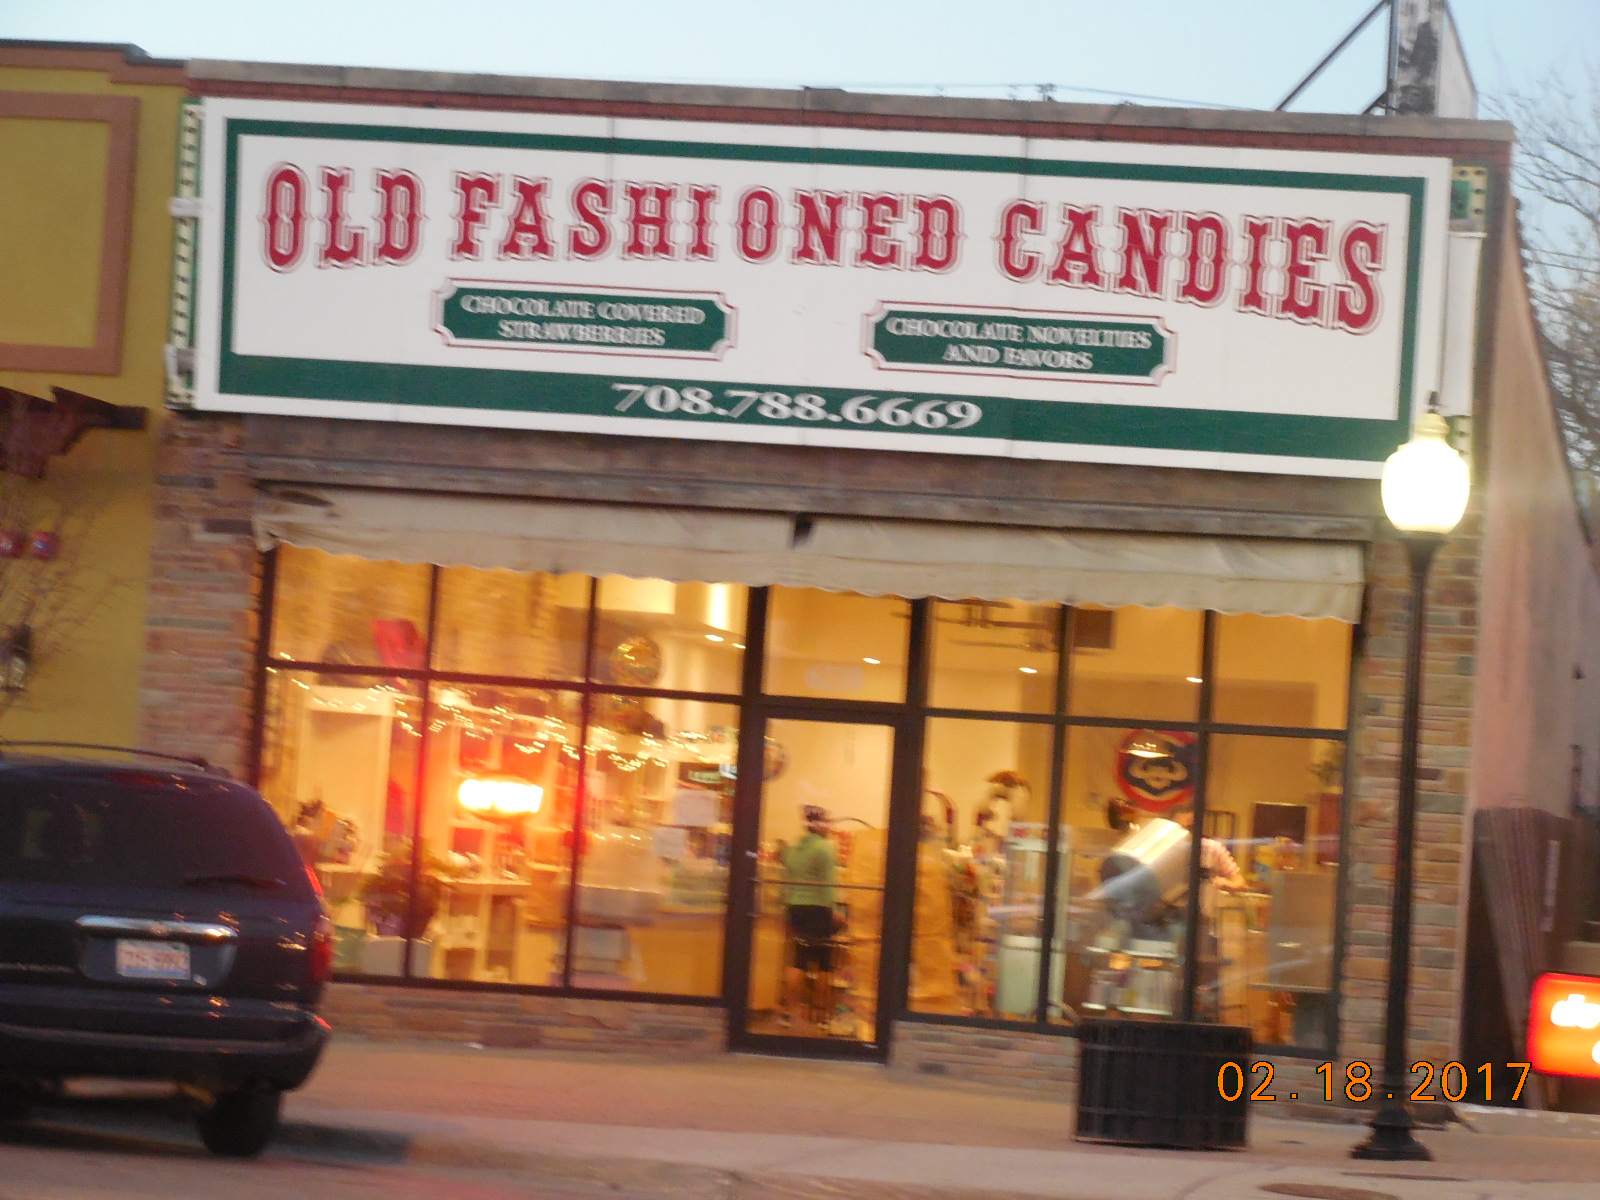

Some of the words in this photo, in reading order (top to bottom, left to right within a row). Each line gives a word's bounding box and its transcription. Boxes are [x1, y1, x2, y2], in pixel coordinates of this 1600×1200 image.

[262, 162, 424, 273] OLD
[448, 171, 965, 275] FASHIONED
[996, 199, 1388, 335] CANDIES
[460, 294, 595, 319] CHOCOLATE
[596, 302, 706, 324] COVERED
[497, 319, 666, 346] STRAWBERRIES
[885, 317, 1024, 342] CHOCOLATE
[1026, 326, 1152, 349] NOVELTIES
[942, 344, 1000, 364] AND
[1003, 347, 1094, 370] FAVORS
[611, 382, 983, 429] 708.788.6669
